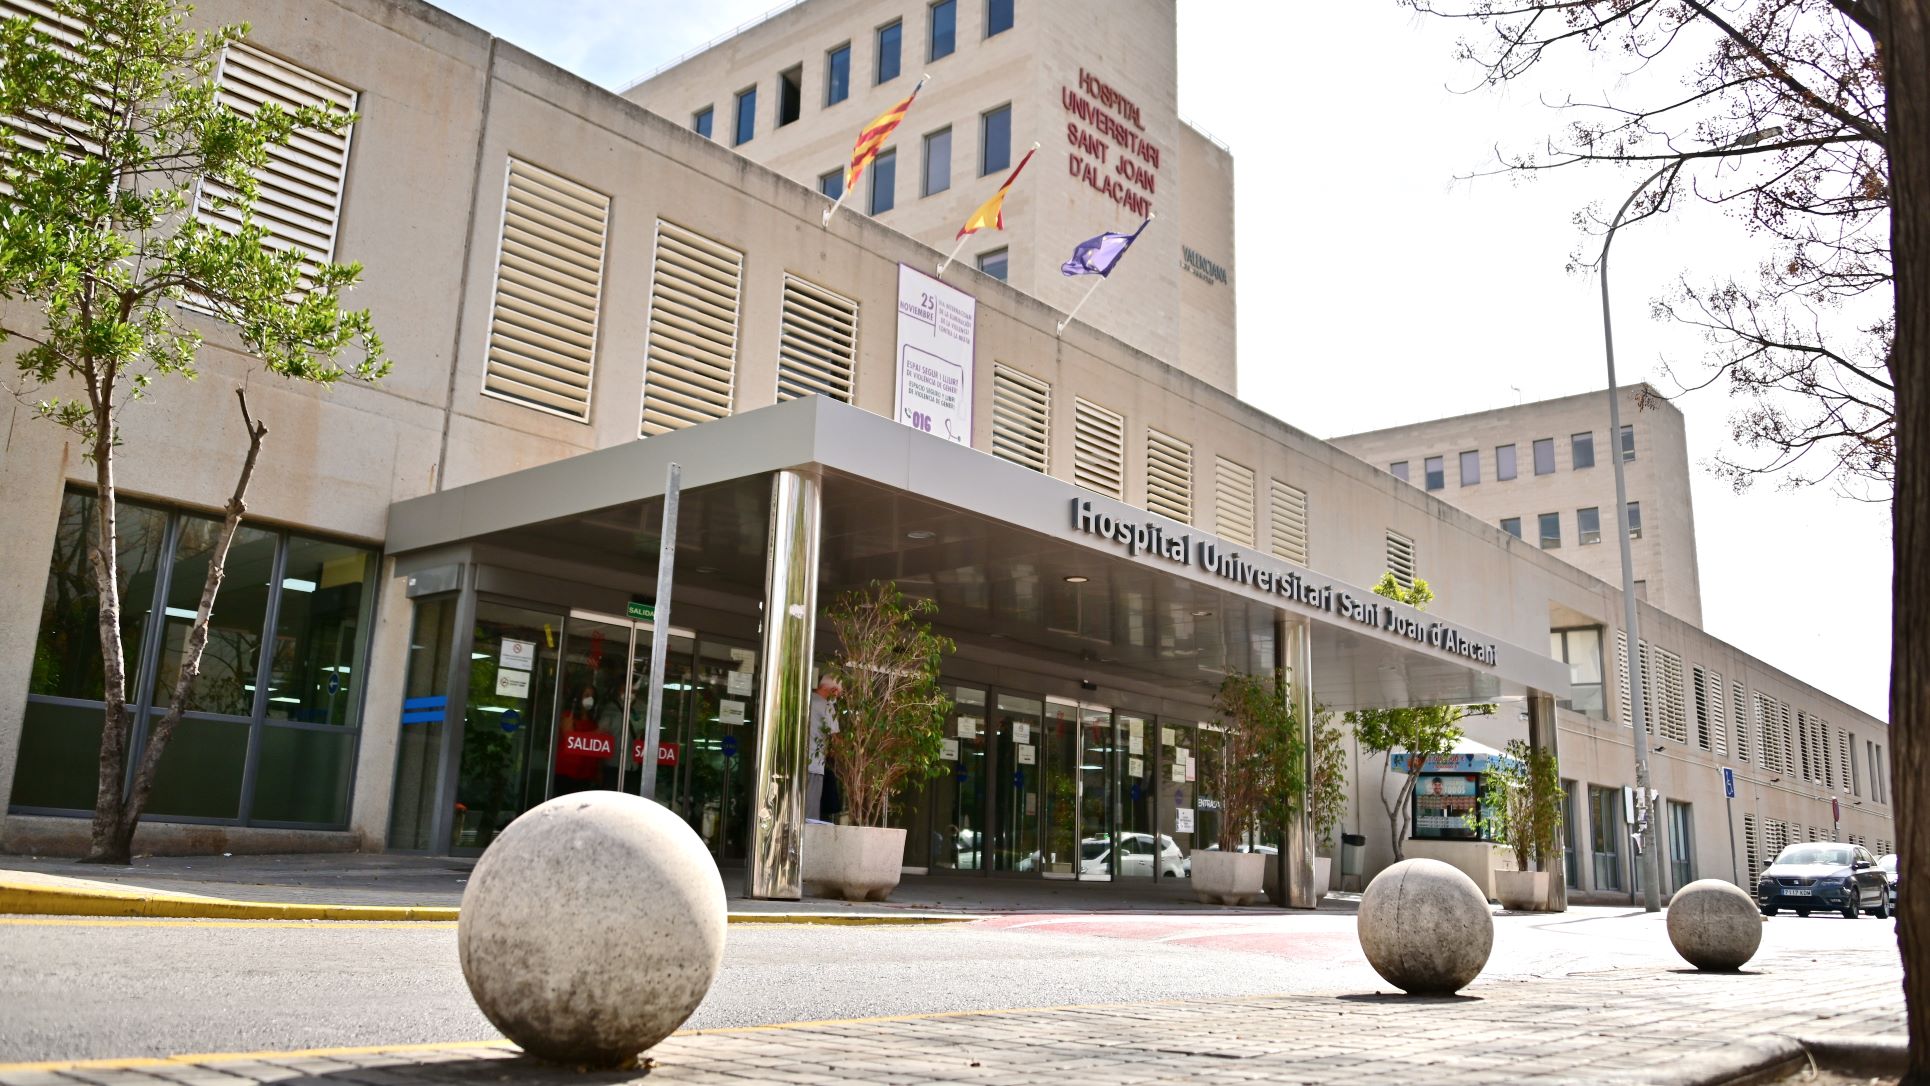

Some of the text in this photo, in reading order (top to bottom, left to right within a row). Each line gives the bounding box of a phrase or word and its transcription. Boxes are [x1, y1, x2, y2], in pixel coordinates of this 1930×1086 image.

[1079, 67, 1145, 131] HOSPITAL
[1062, 86, 1159, 169] UNIVERSITARI
[1067, 122, 1155, 194] SANT JOAN
[1069, 153, 1151, 219] D'ALACANT
[900, 300, 934, 321] NOVIEMBRE
[921, 292, 934, 310] 25
[906, 369, 912, 377] DE
[907, 360, 921, 372] ESPAI
[922, 366, 938, 379] SEGUR
[912, 411, 932, 432] 016
[1072, 498, 1498, 666] Hospital Universitari Sant Joan d'Alacant
[567, 735, 610, 753] SALIDA
[635, 745, 675, 761] SADA
